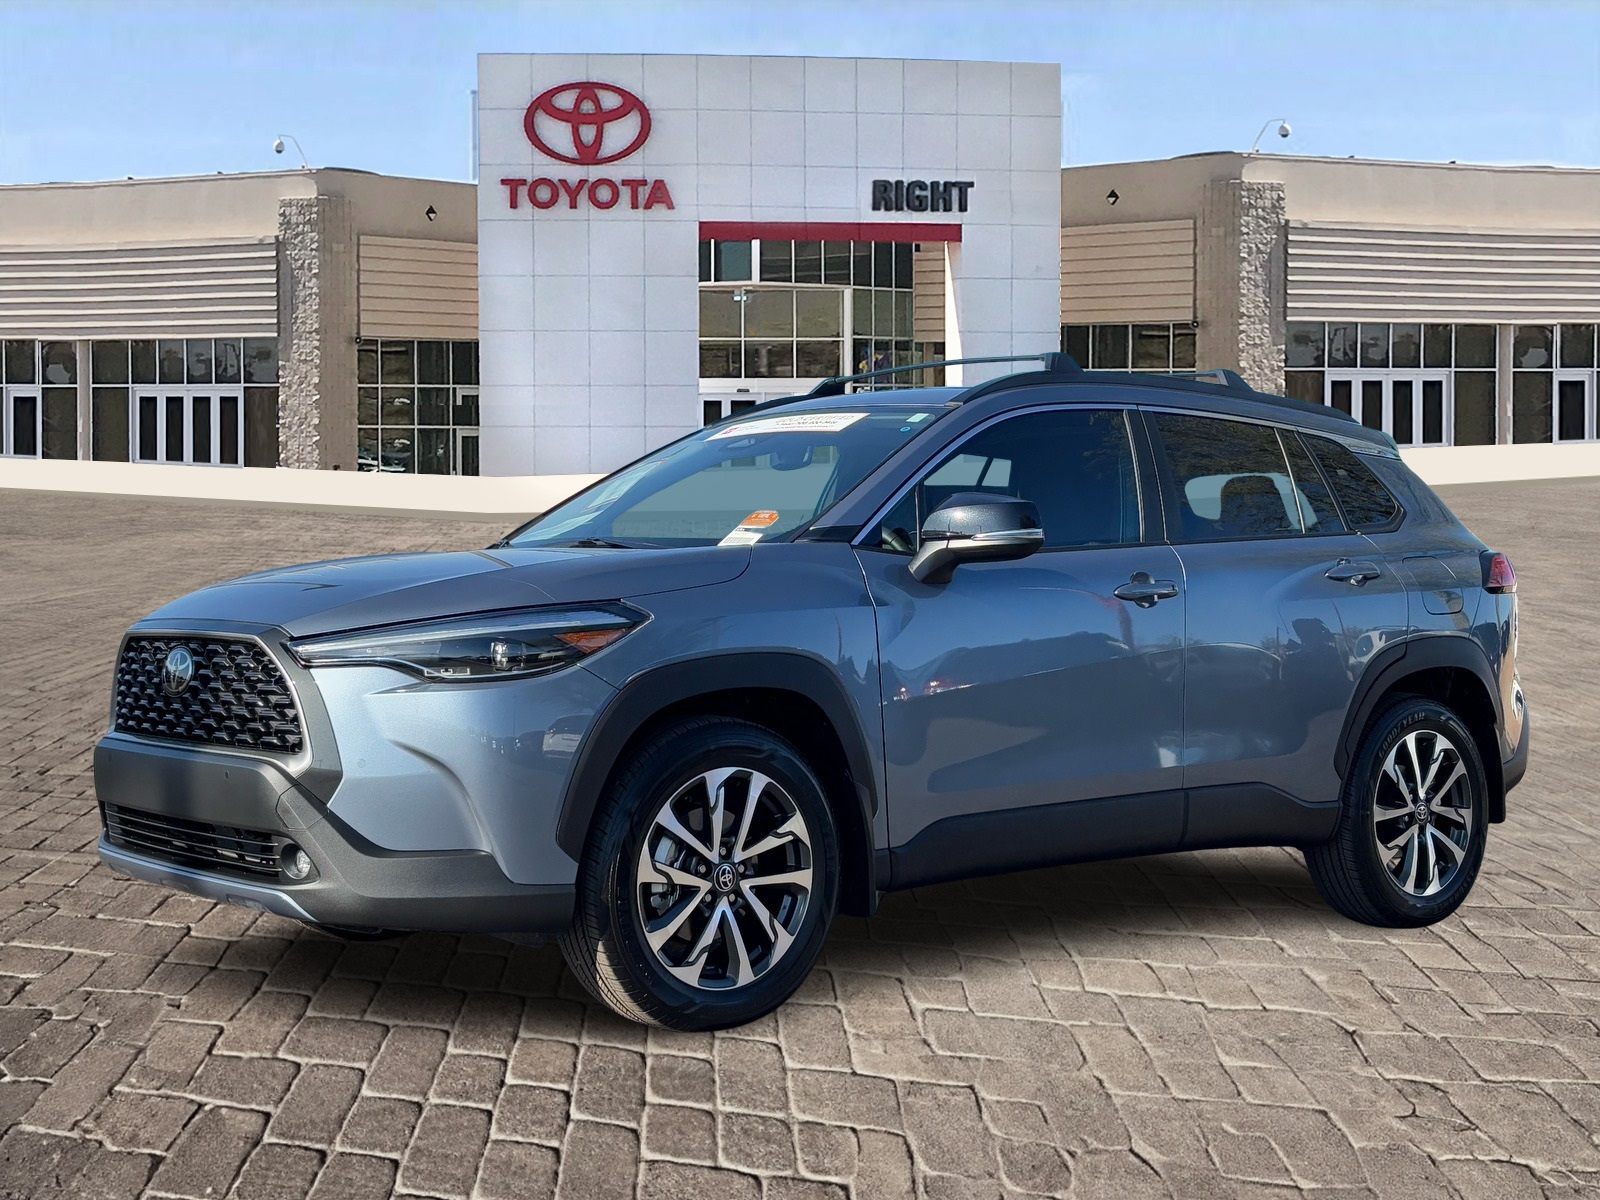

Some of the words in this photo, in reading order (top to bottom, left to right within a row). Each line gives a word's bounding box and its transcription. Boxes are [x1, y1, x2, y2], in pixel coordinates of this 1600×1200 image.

[500, 178, 675, 210] TOYOTA
[872, 179, 975, 212] RIGHT
[1378, 711, 1426, 758] GOODYEAR
